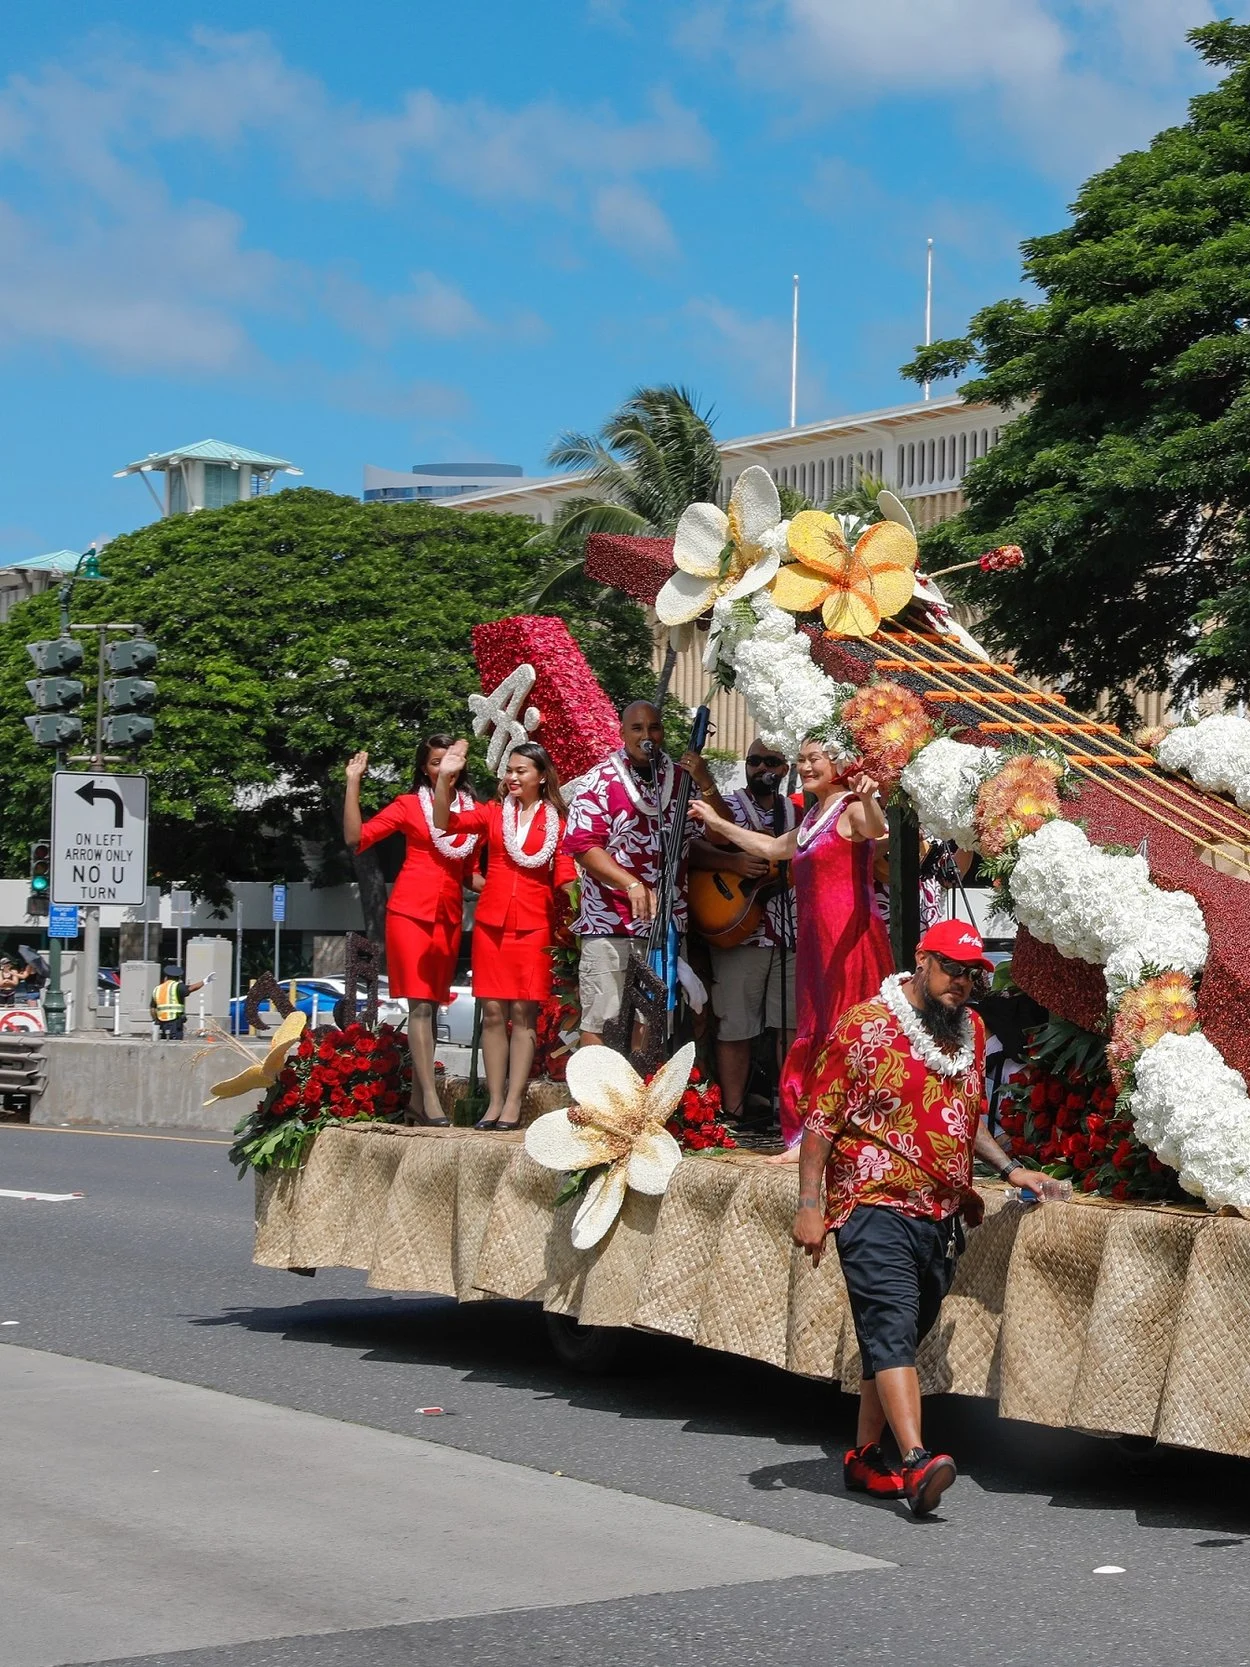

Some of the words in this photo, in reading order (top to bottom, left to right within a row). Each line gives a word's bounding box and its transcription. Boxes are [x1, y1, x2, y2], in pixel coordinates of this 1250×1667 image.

[75, 833, 91, 846] ON
[96, 834, 123, 846] LEFT
[65, 848, 102, 861] ARROW
[106, 849, 133, 862] ONLY
[73, 865, 100, 883] NO
[112, 866, 124, 884] U
[80, 886, 116, 899] TURN
